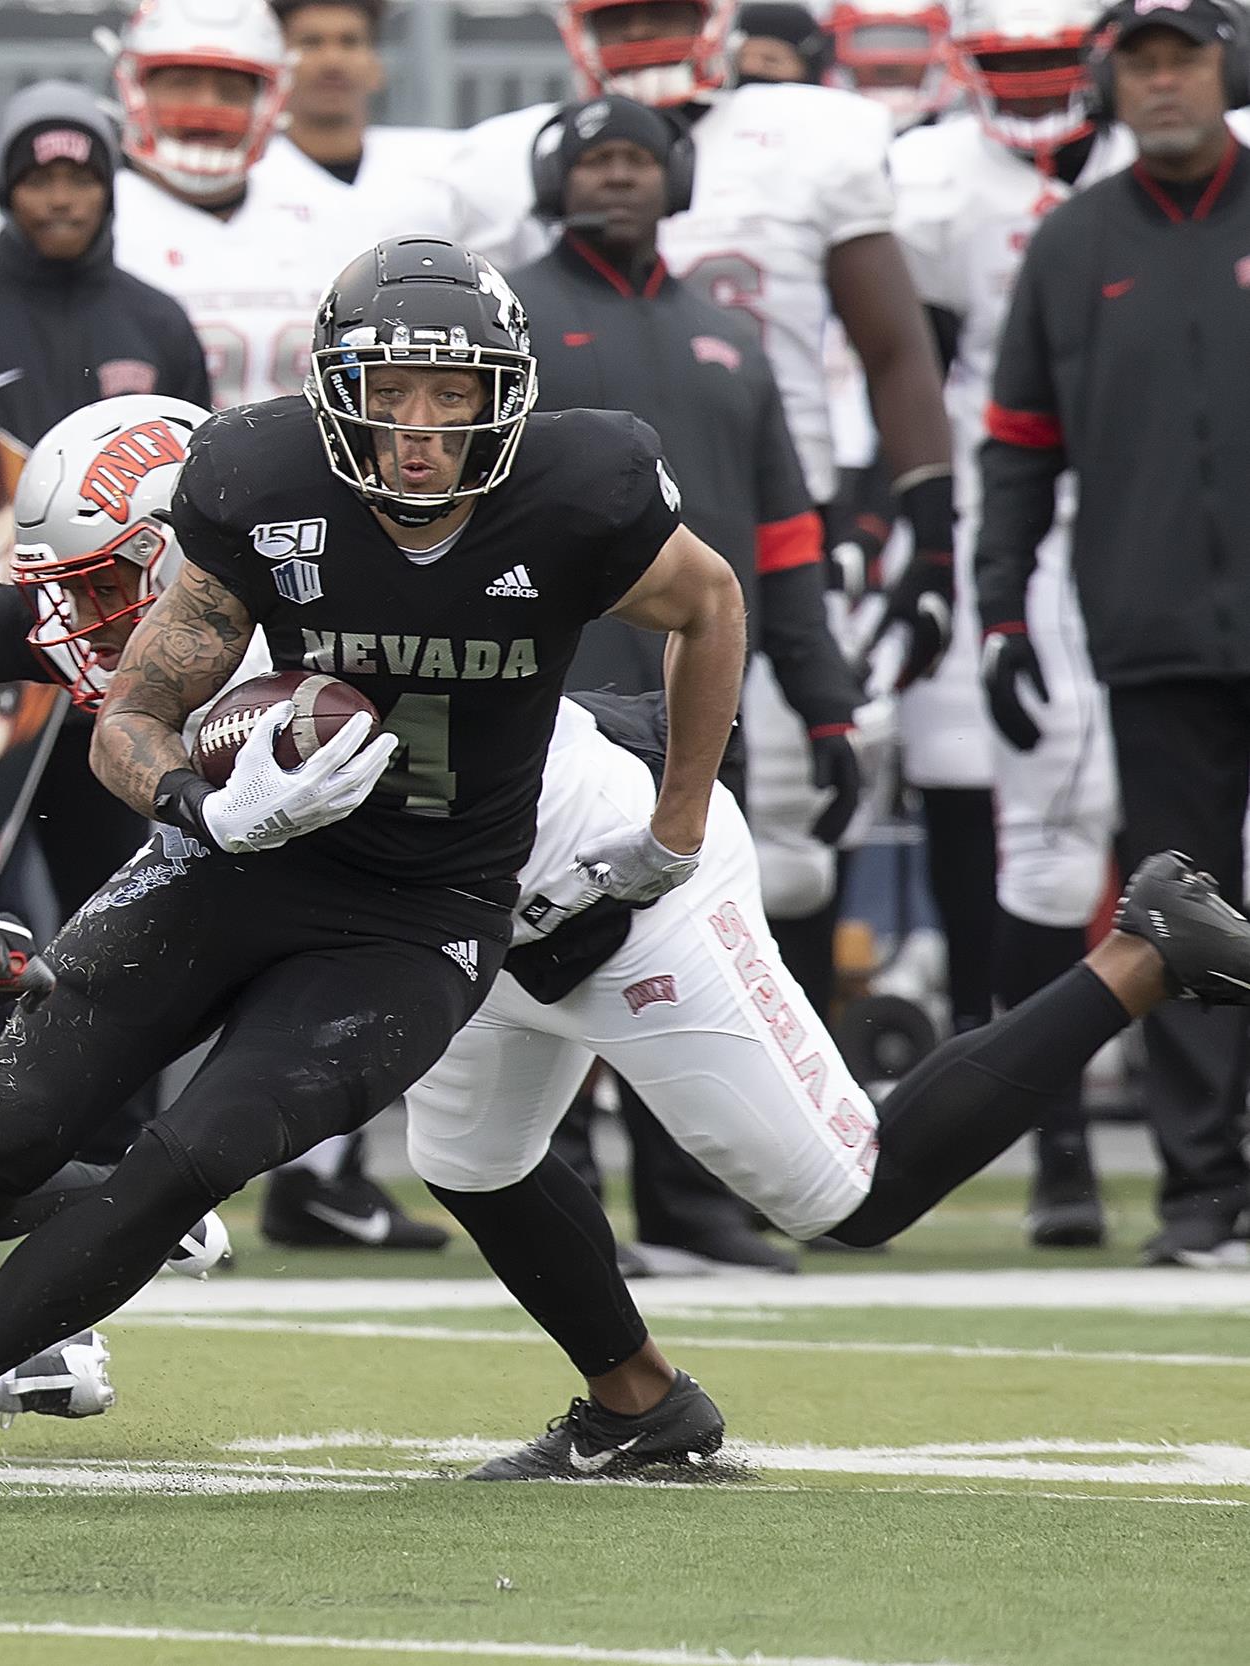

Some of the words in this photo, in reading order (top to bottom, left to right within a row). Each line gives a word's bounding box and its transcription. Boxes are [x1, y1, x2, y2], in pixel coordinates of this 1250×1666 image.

[79, 420, 187, 524] UNLV
[249, 518, 326, 558] 150
[485, 584, 539, 599] adidas
[301, 628, 539, 680] NEVADA
[441, 945, 479, 982] adidas
